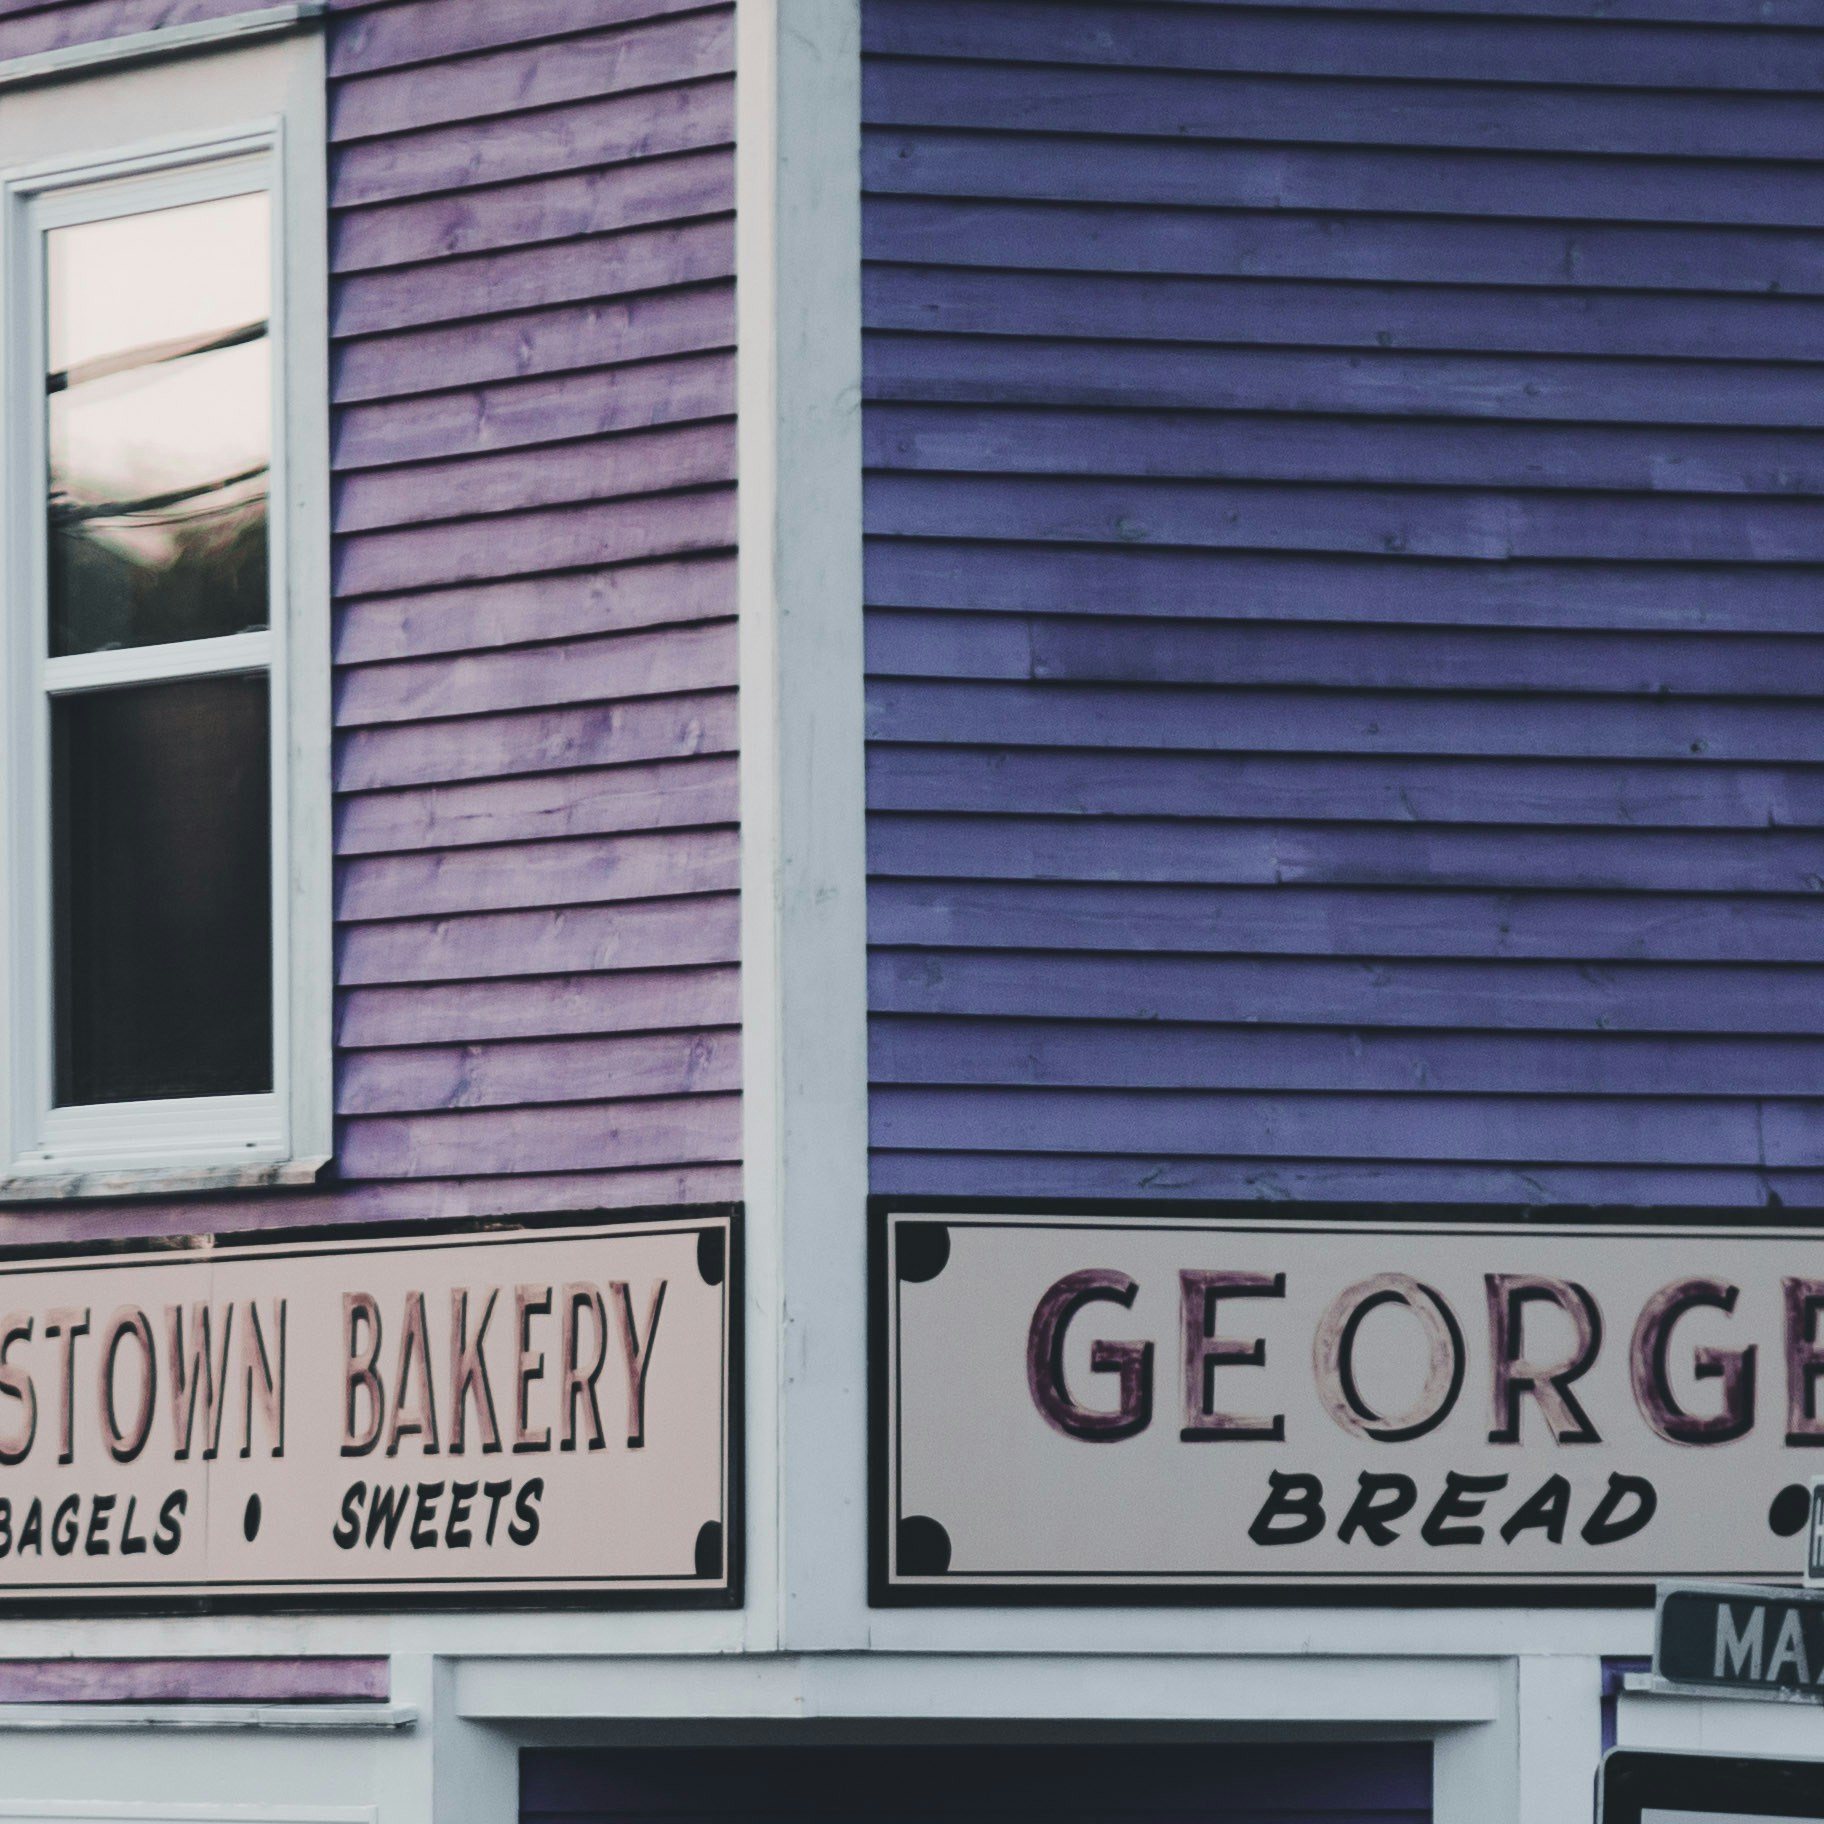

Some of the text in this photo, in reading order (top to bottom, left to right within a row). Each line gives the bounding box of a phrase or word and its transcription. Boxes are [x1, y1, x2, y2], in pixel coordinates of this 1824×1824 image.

[338, 1277, 669, 1460] BAKERY
[332, 1476, 546, 1552] SWEETS
[1247, 1469, 1658, 1548] BREAD
